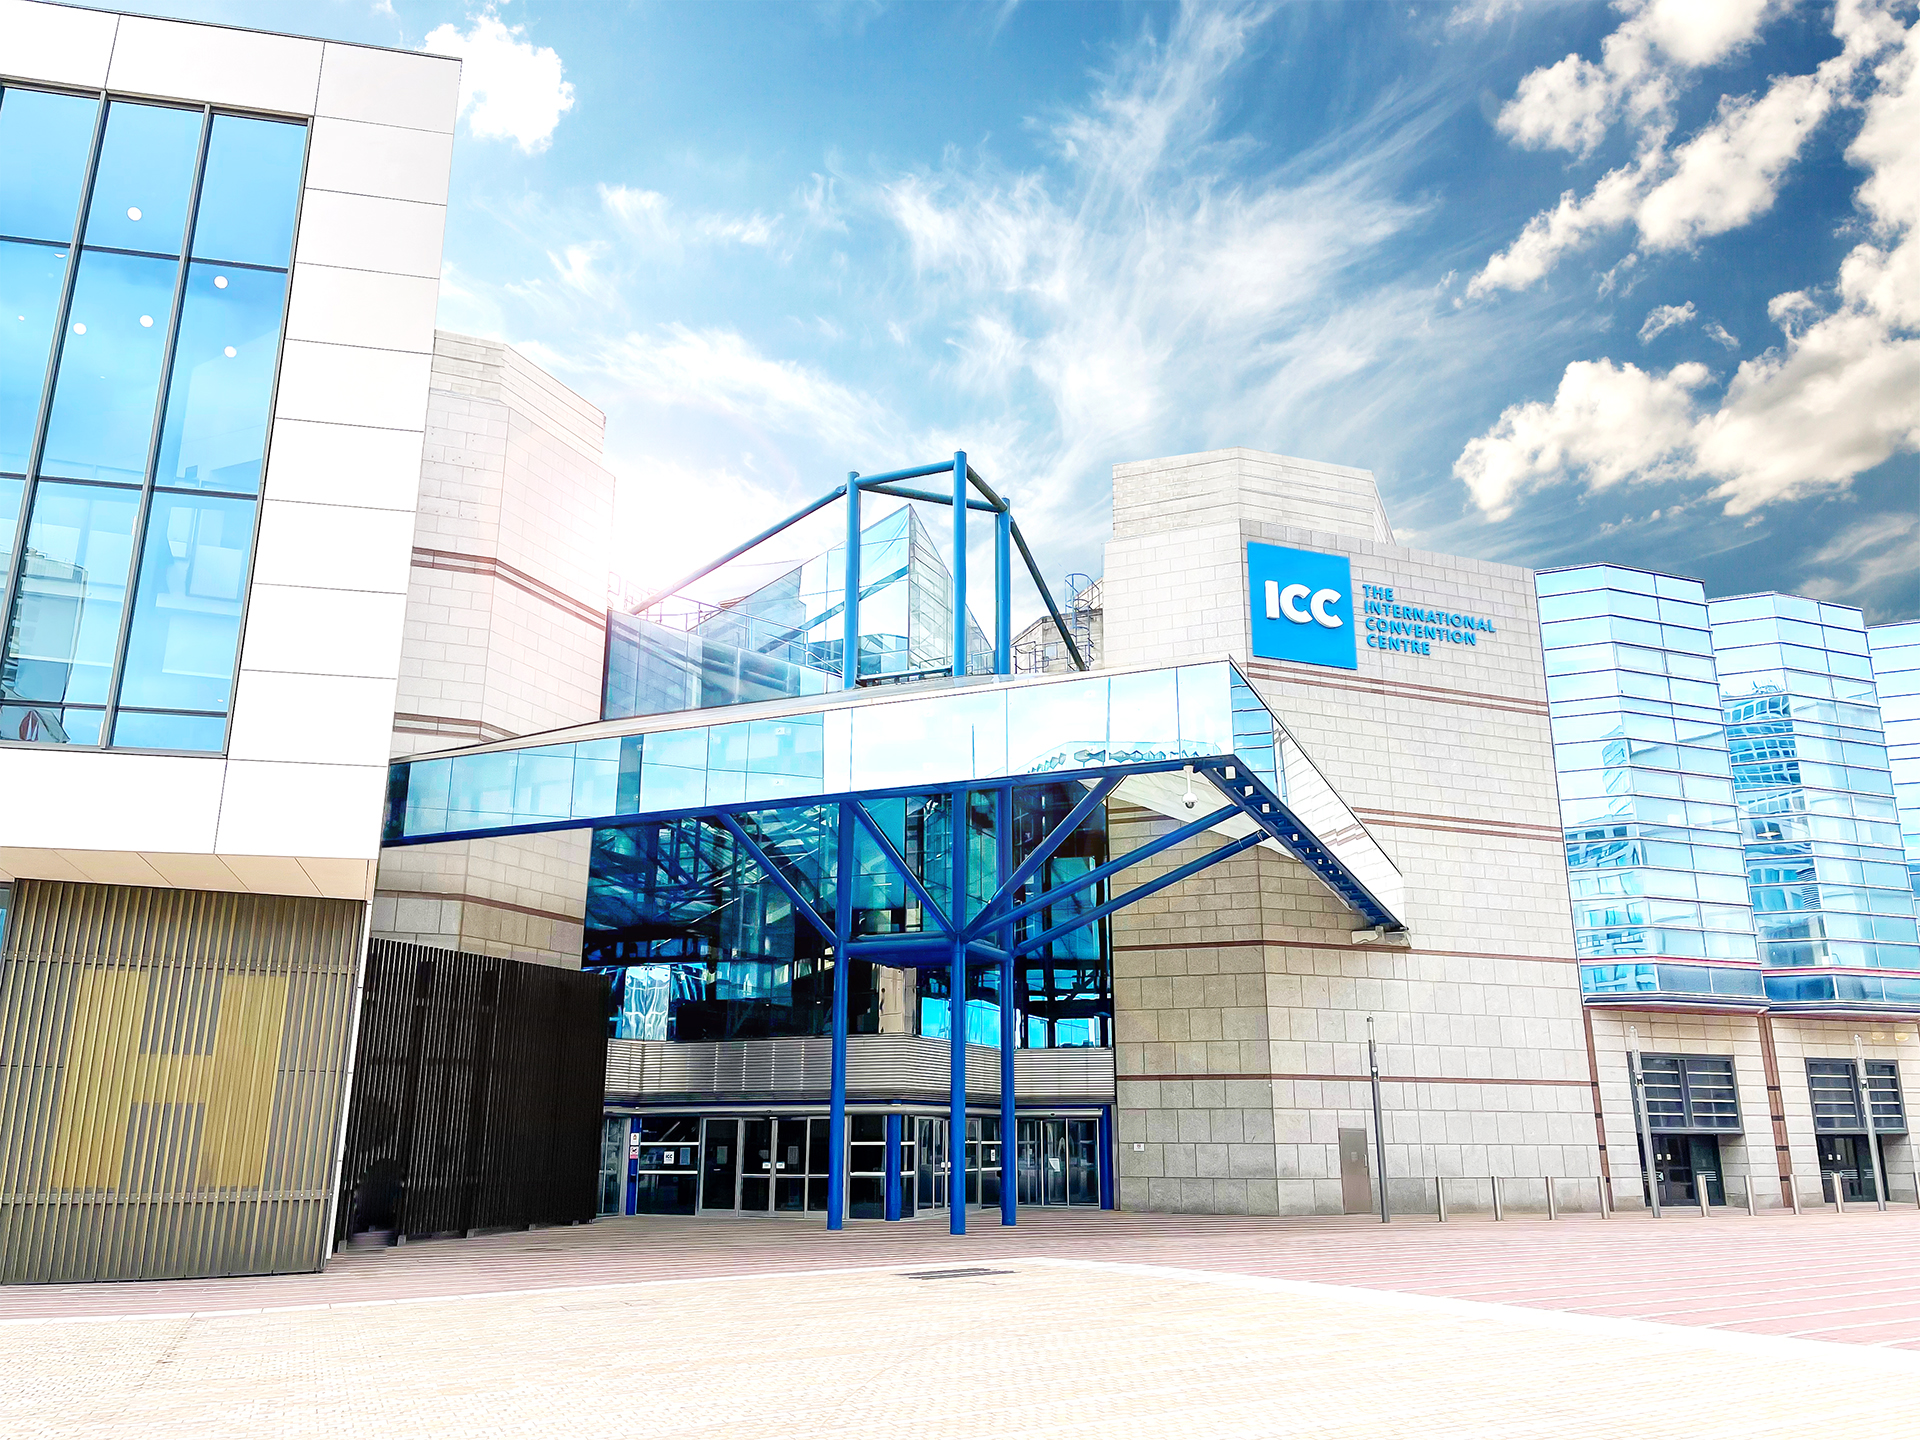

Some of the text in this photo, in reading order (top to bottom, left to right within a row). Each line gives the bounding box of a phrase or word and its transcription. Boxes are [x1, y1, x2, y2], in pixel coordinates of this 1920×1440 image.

[1264, 579, 1344, 628] ICC
[1362, 584, 1394, 601] THE
[1364, 601, 1496, 633] INTERNATIONAL
[1365, 617, 1476, 646] CONVENTION
[1366, 634, 1431, 655] CENTRE
